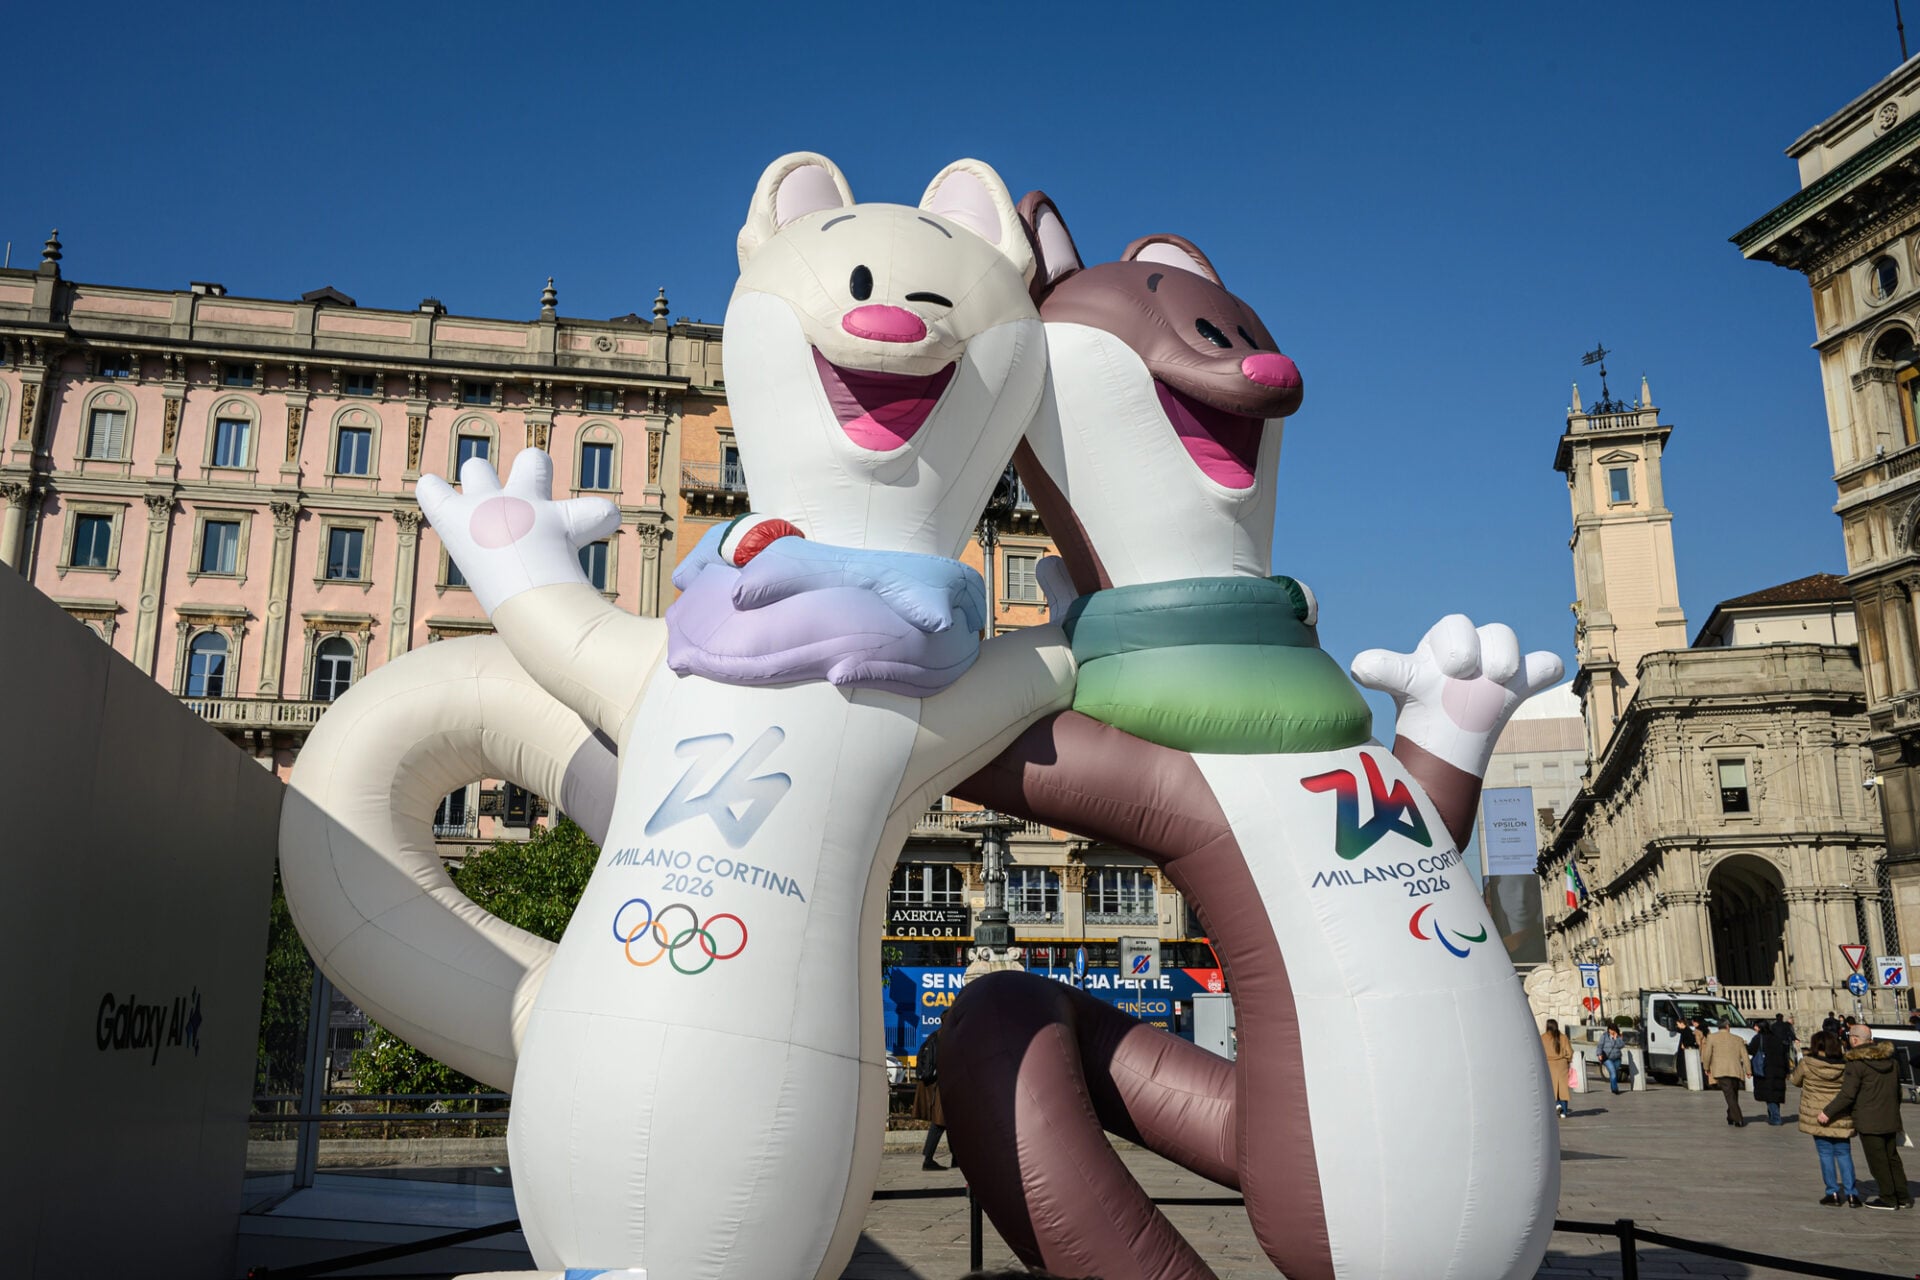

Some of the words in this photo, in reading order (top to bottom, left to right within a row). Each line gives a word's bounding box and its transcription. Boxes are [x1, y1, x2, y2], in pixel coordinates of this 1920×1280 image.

[1492, 821, 1527, 829] YPSILON
[607, 848, 692, 870] MILANO
[696, 854, 807, 904] CORTINA
[1311, 862, 1415, 888] MILANO
[1417, 847, 1463, 874] CORTI
[661, 872, 714, 898] 2026
[1403, 874, 1450, 897] 2026
[891, 909, 946, 922] AXERTA
[896, 926, 961, 937] CALORI
[922, 973, 944, 988] SE
[948, 973, 966, 988] N
[1117, 1001, 1167, 1013] FINECO
[96, 992, 168, 1066] Galaxy
[166, 996, 187, 1047] AI
